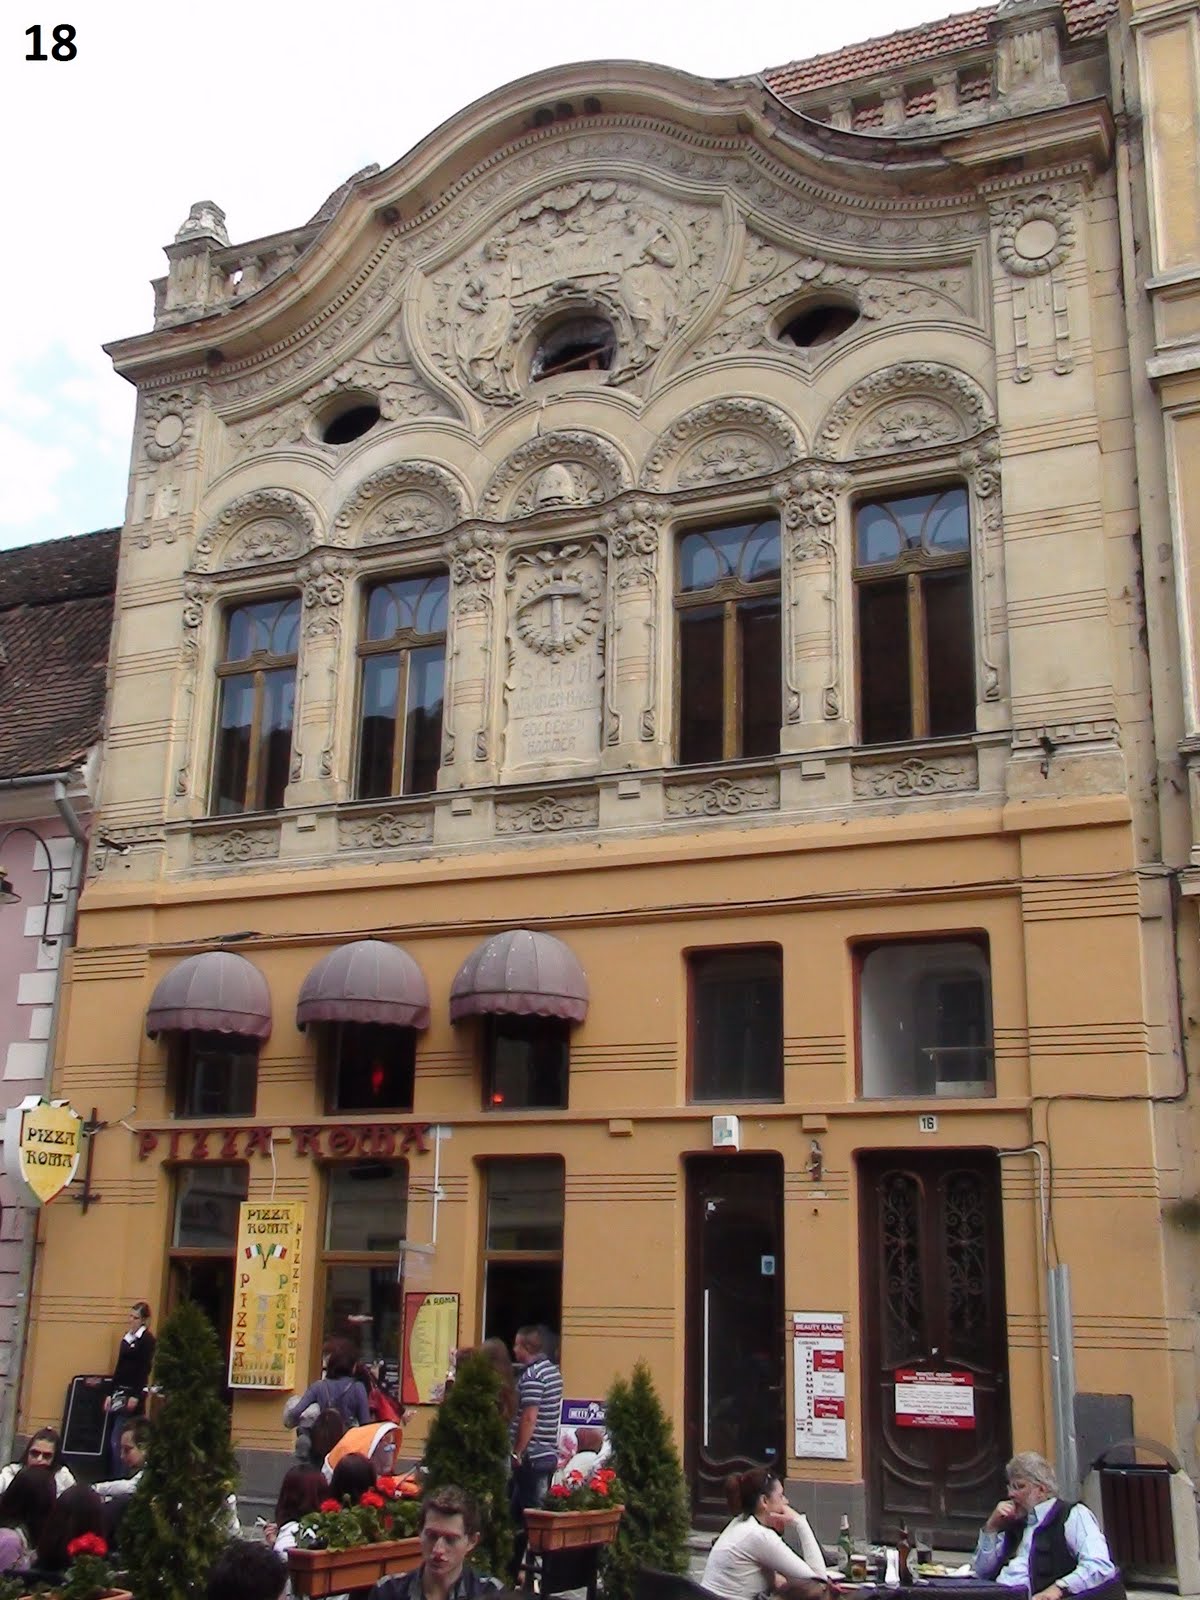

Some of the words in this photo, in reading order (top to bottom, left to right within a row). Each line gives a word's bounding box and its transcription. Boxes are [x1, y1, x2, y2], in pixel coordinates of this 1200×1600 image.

[922, 1116, 934, 1130] 16
[26, 1127, 76, 1146] PIZZA
[138, 1126, 273, 1162] PIZZA
[294, 1123, 430, 1159] ROMA
[26, 1149, 73, 1168] ROMA
[247, 1208, 291, 1221] PIZZA
[247, 1222, 290, 1235] ROMA
[292, 1222, 303, 1294] PIZZA
[234, 1272, 251, 1368] PIZZA
[270, 1273, 289, 1371] PASTA
